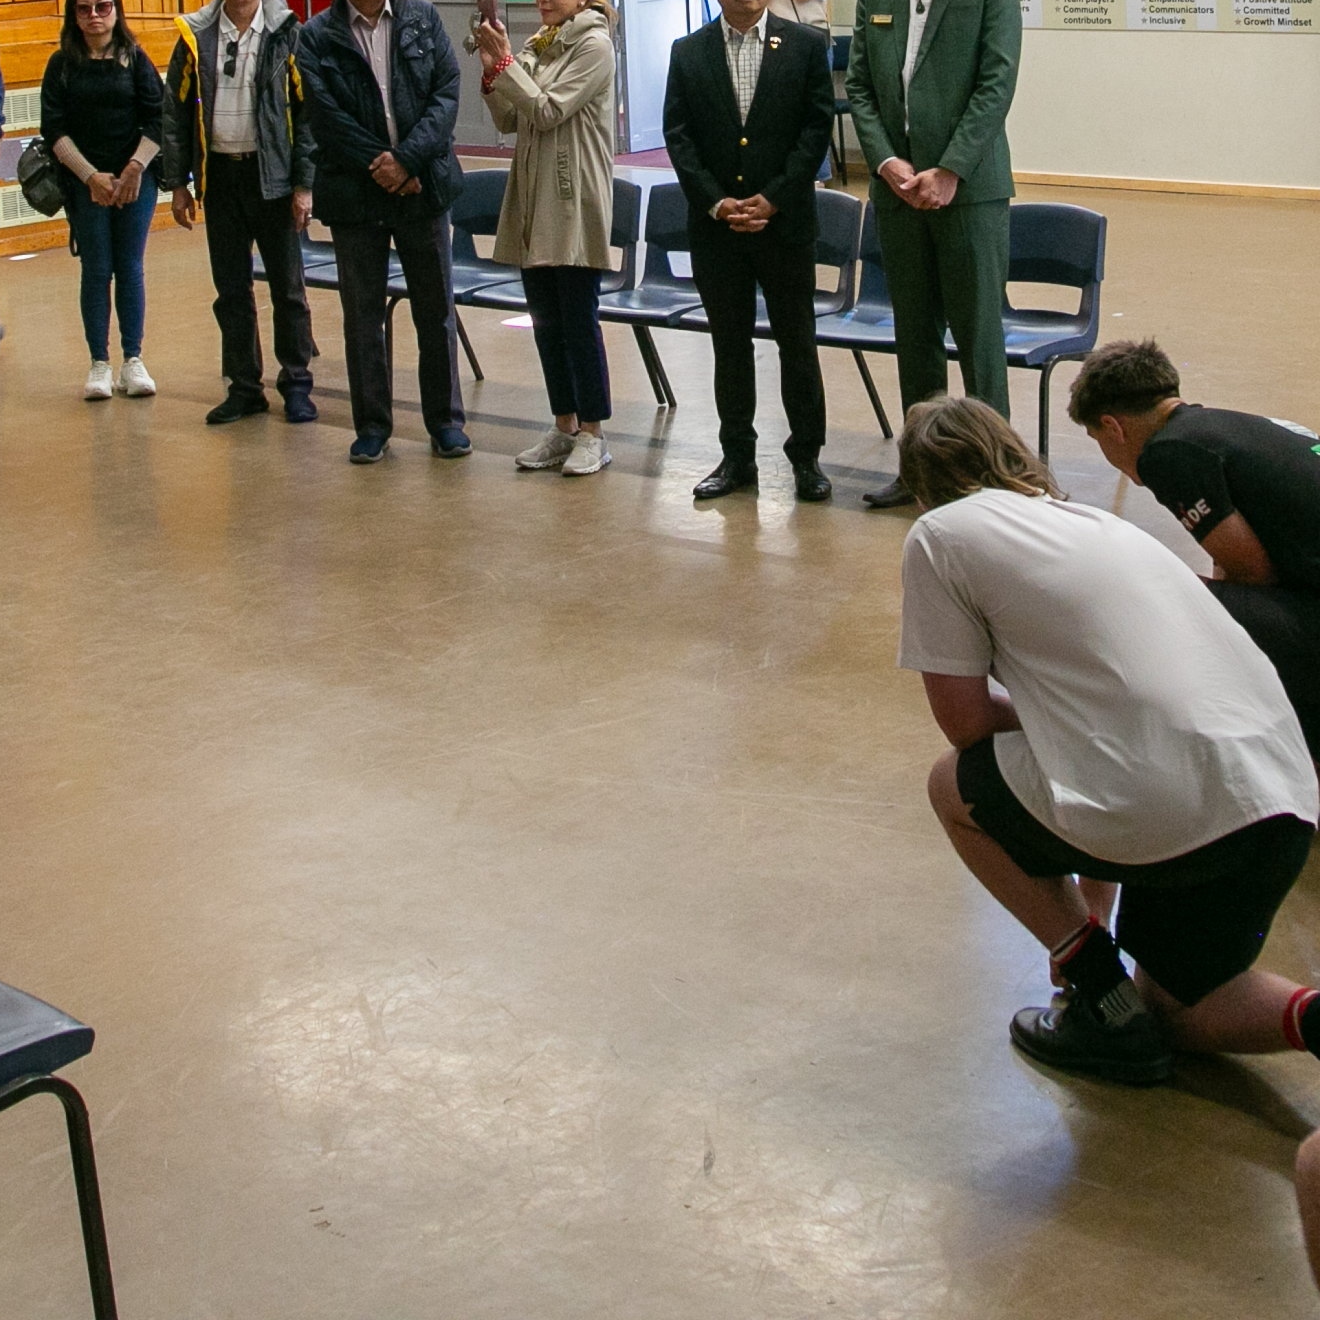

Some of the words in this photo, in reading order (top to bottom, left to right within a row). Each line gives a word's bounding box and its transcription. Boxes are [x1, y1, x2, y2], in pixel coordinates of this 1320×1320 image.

[1063, 6, 1108, 15] Community
[1149, 6, 1214, 14] Communicators
[1243, 7, 1290, 15] Committed
[1064, 16, 1112, 24] contributors
[1149, 17, 1186, 25] Inclusive
[1243, 18, 1275, 27] Growth
[1278, 18, 1312, 27] Mindset
